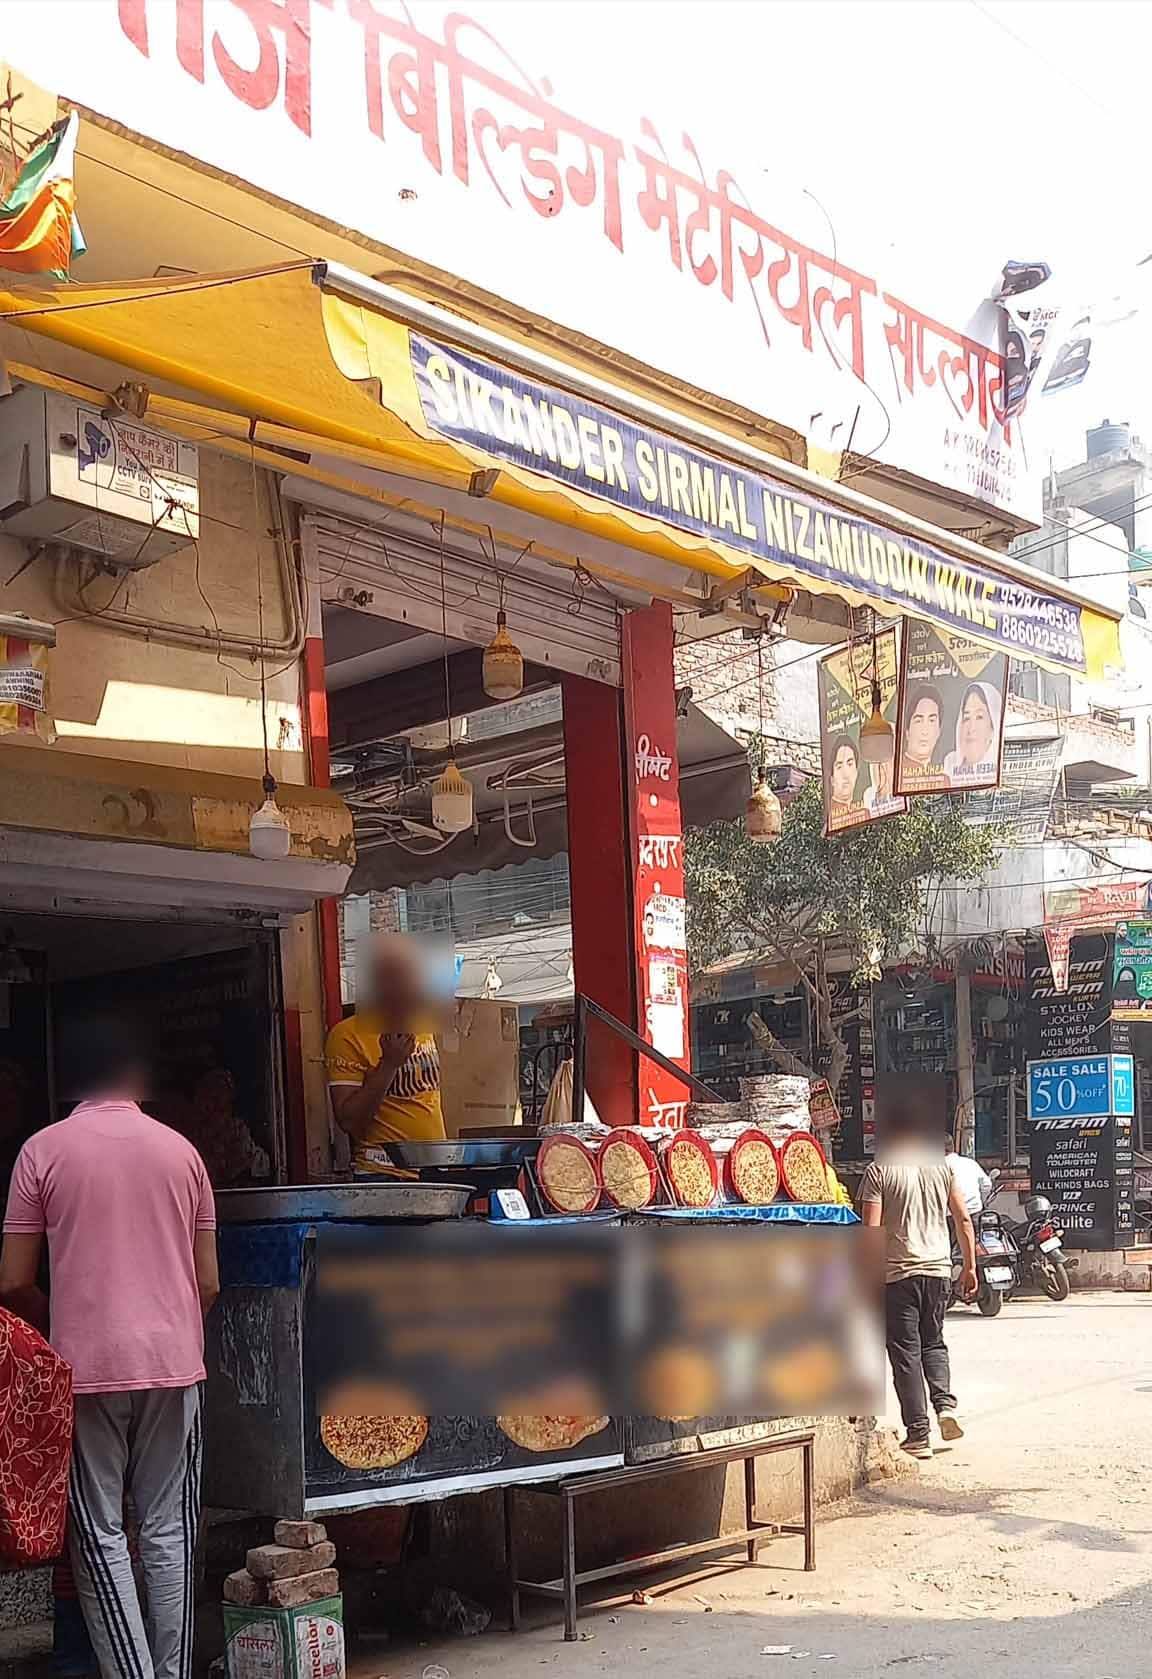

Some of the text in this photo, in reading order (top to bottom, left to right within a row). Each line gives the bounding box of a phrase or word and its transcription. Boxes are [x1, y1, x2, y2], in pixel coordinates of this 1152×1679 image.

[125, 458, 138, 470] You
[117, 465, 137, 479] CCTV
[425, 354, 998, 631] SIKANDER SIRMAL NIZAMUDDIN WALE
[1031, 960, 1105, 978] NIAM
[1040, 1002, 1096, 1016] STYLOX
[1047, 1014, 1089, 1025] JOCKEY
[1040, 1024, 1096, 1038] KIDS WEAR
[1047, 1039, 1063, 1047] ALL
[1040, 1045, 1098, 1057] ACCESSORIES
[1033, 1063, 1106, 1079] SALE SALE
[647, 1087, 687, 1130] रेता
[1056, 1138, 1088, 1150] safari
[1047, 1152, 1098, 1160] AMERICAN
[1046, 1158, 1097, 1167] TOURISTER
[1049, 1168, 1095, 1178] WILDCRAFT
[1036, 1180, 1110, 1190] ALL KINDS BAGS
[1050, 1202, 1096, 1212] PRINCE
[1053, 1215, 1094, 1229] Sulite
